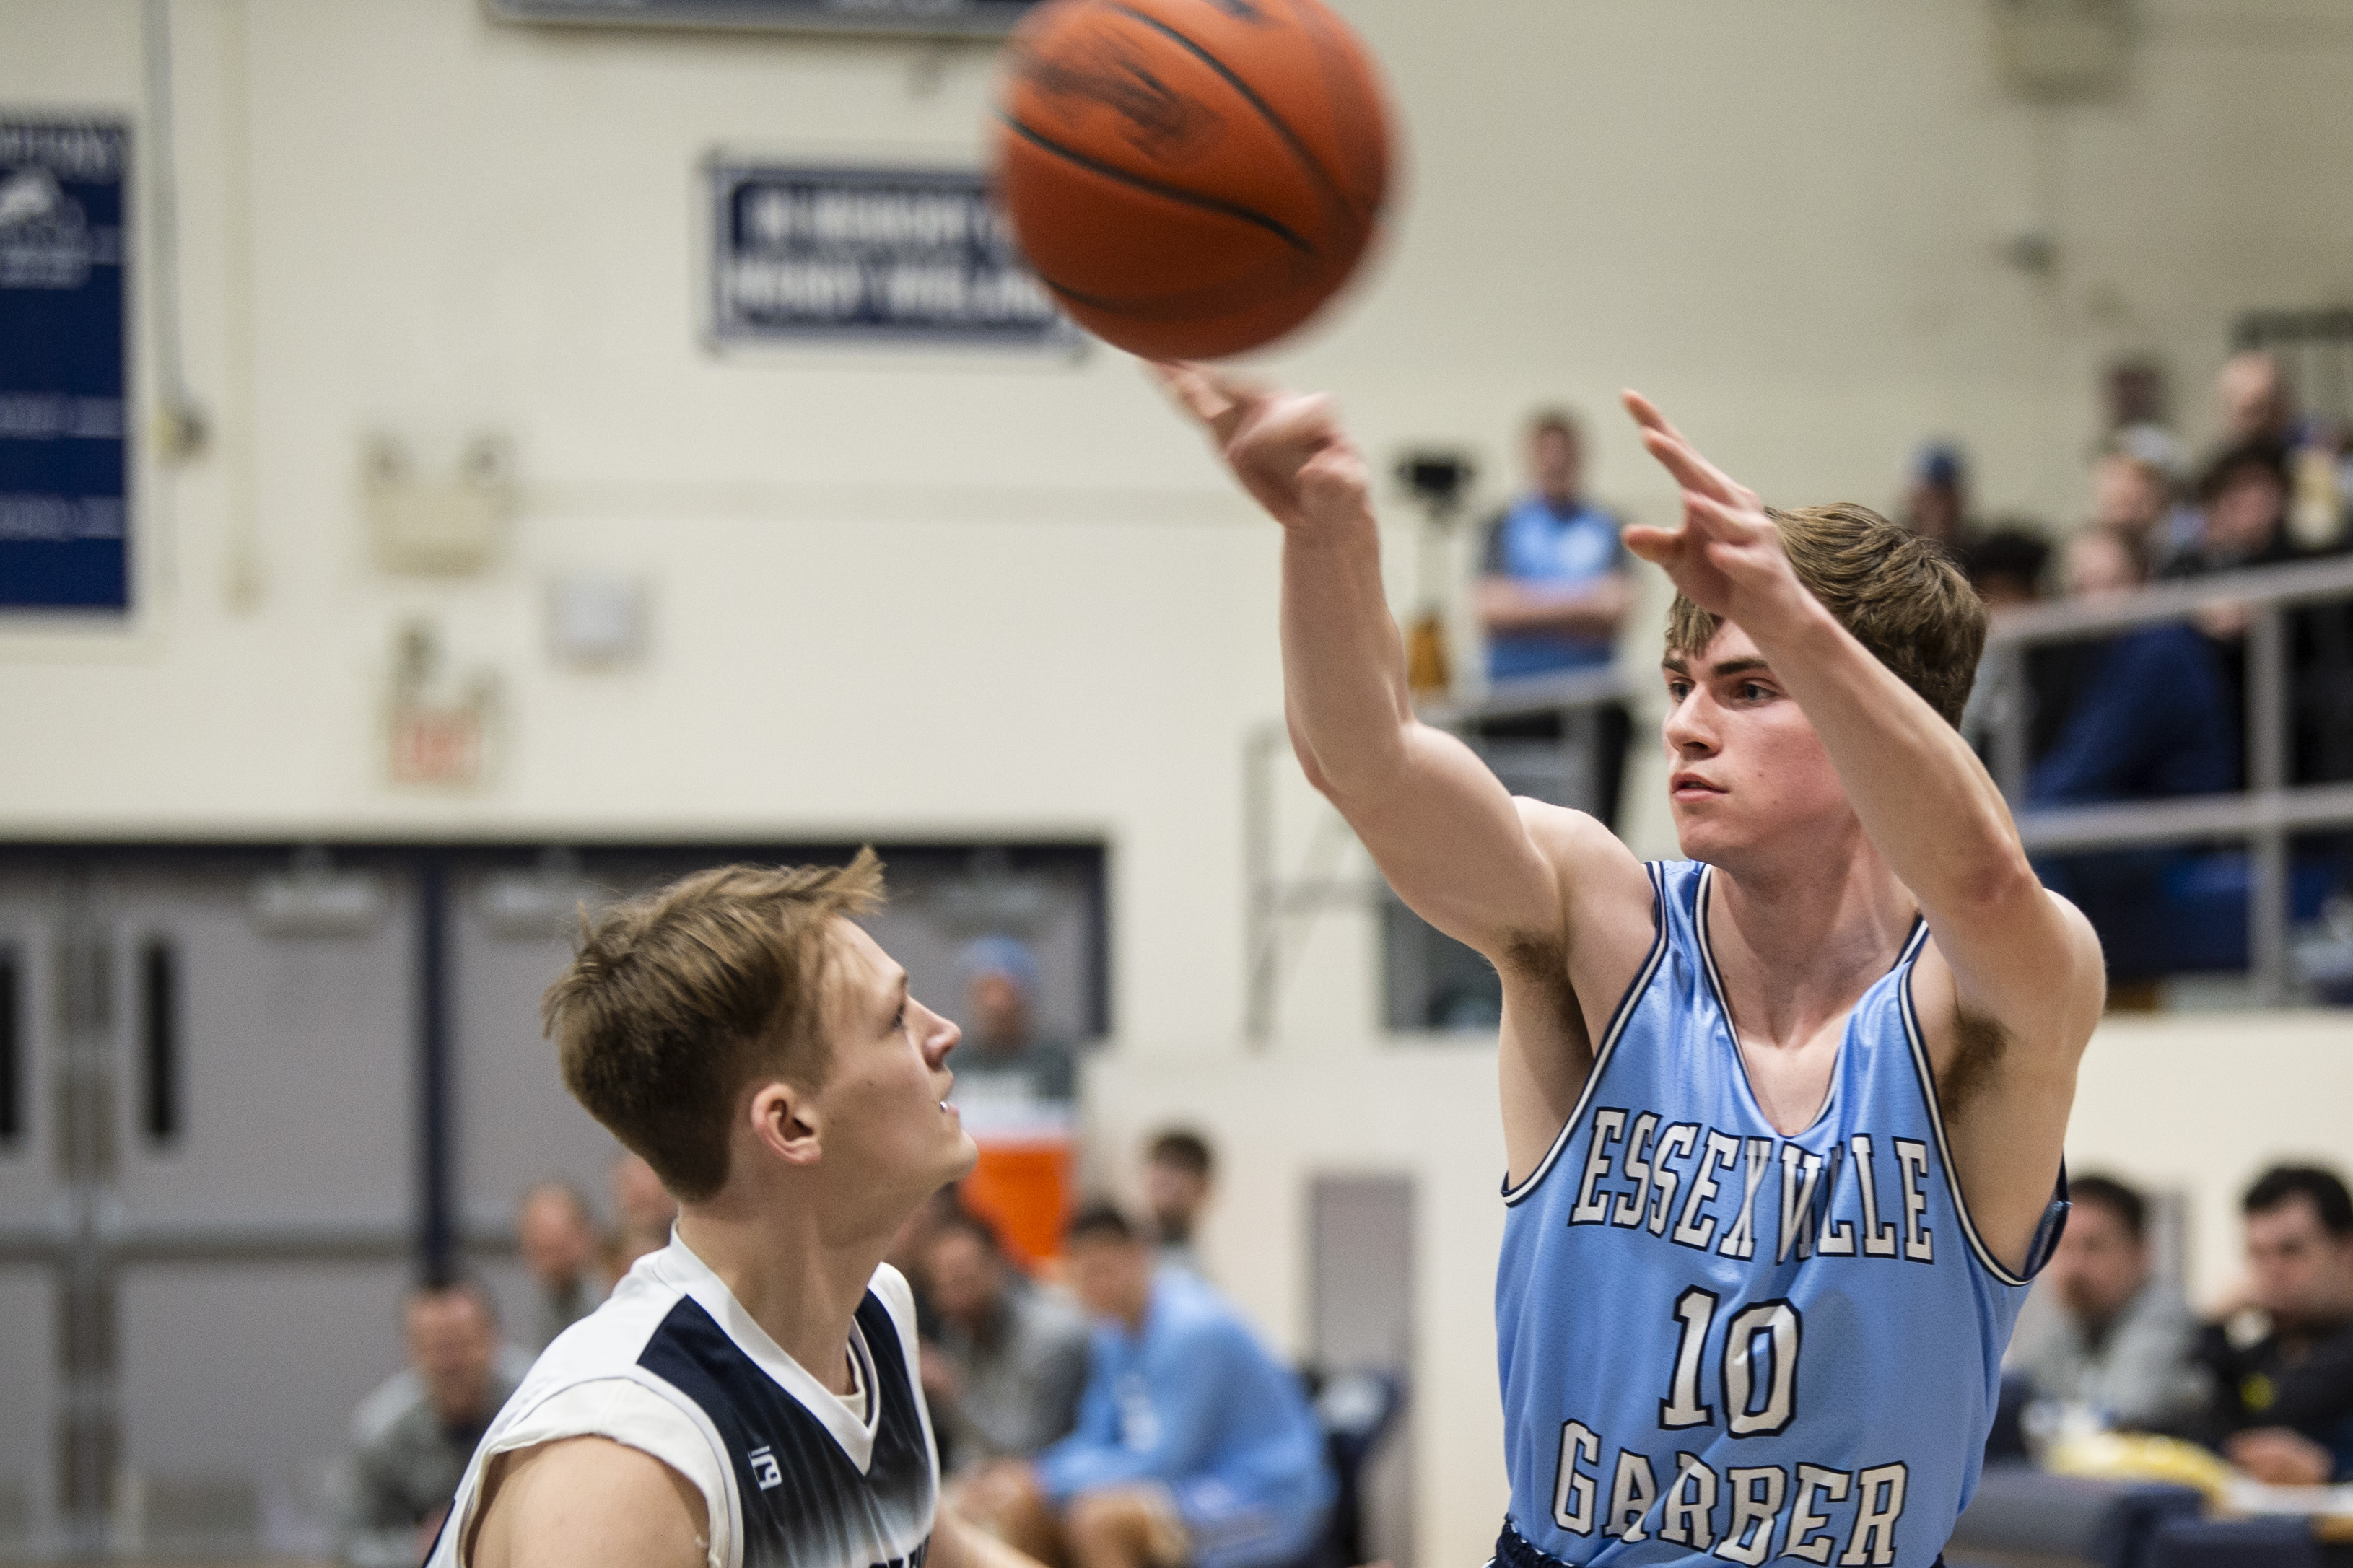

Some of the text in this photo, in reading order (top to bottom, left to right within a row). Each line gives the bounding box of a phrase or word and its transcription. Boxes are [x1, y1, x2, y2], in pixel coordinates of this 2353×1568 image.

[1569, 1106, 1933, 1266] ESSEXVILLE
[1659, 1284, 1802, 1437] 10
[1553, 1419, 1909, 1567] GARBER
